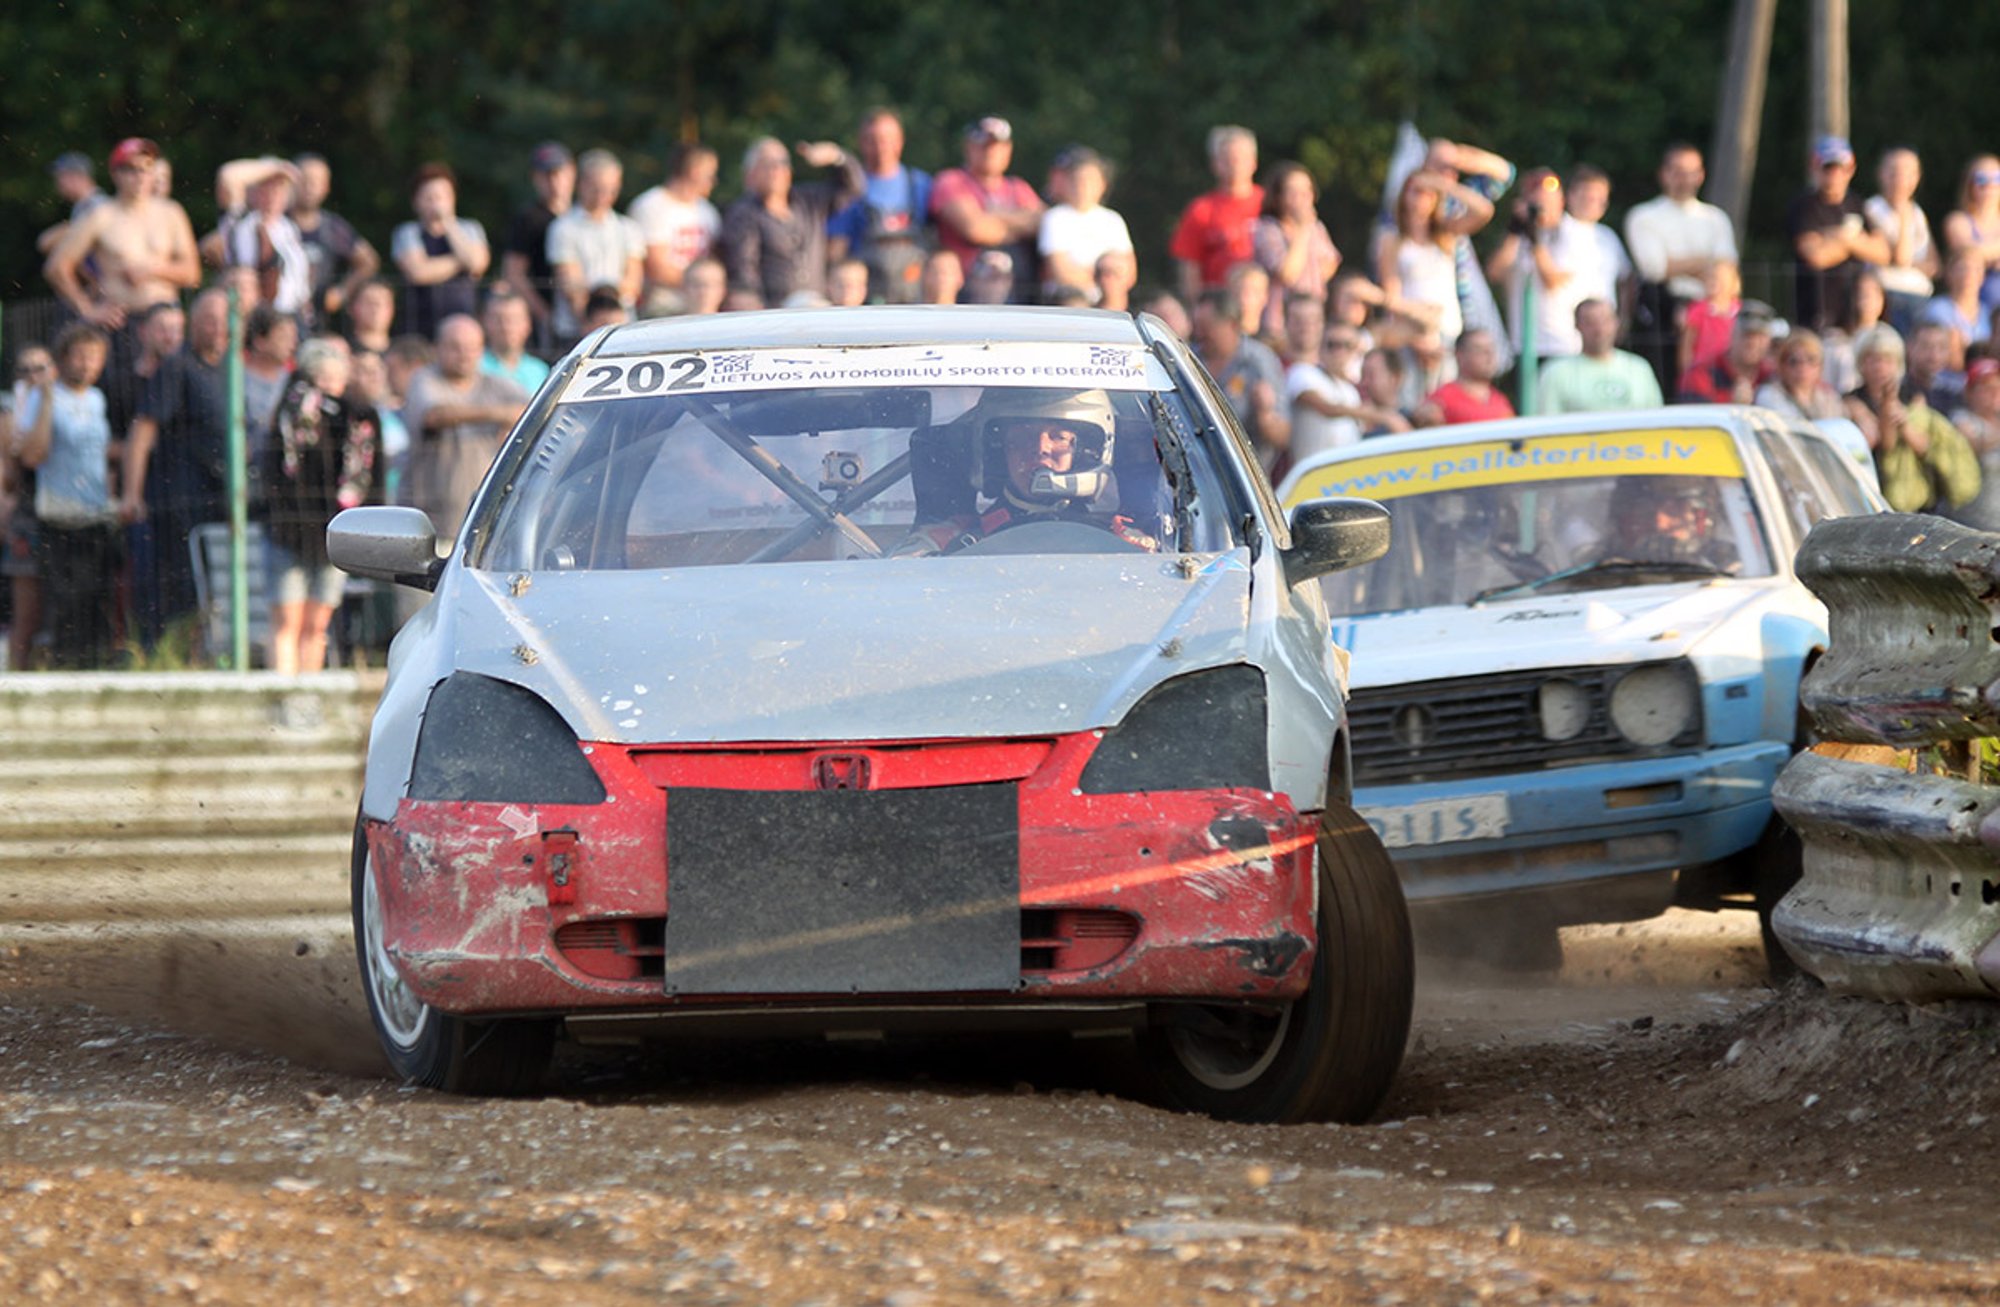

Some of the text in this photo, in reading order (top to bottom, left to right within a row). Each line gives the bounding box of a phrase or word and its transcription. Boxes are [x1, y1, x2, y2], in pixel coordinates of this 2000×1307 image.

[583, 357, 707, 398] 202
[710, 366, 1145, 384] LIETUVOS AUTOMOBILIŲ SPORTO FEDERACIJA
[1319, 439, 1698, 497] www.palleteries.lv
